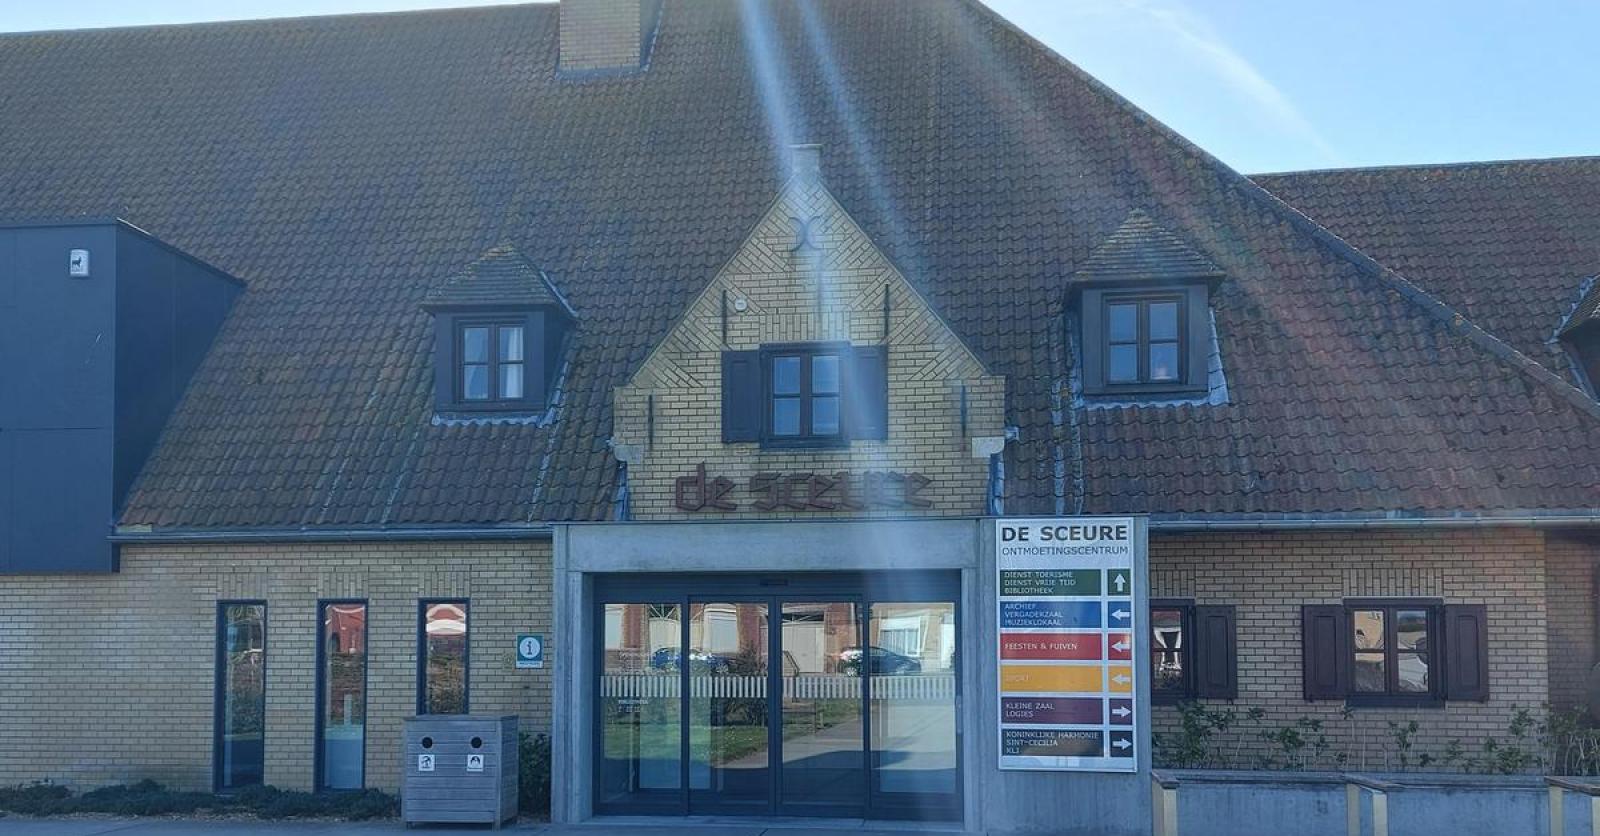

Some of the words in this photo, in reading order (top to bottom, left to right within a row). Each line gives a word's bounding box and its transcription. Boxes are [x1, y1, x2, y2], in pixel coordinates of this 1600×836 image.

[676, 461, 738, 512] de
[1002, 527, 1029, 541] DE
[1040, 525, 1127, 541] SCEURE
[1002, 546, 1128, 556] ONTMOETINGSCENTRUM
[1006, 702, 1033, 710] KLEINE
[1035, 702, 1055, 710] ZAAL
[1006, 710, 1034, 718] LOGIES
[1006, 731, 1055, 739] KONINKLIJKE
[1058, 731, 1098, 739] HARMONIE
[1006, 739, 1058, 747] SINT-CECILIA
